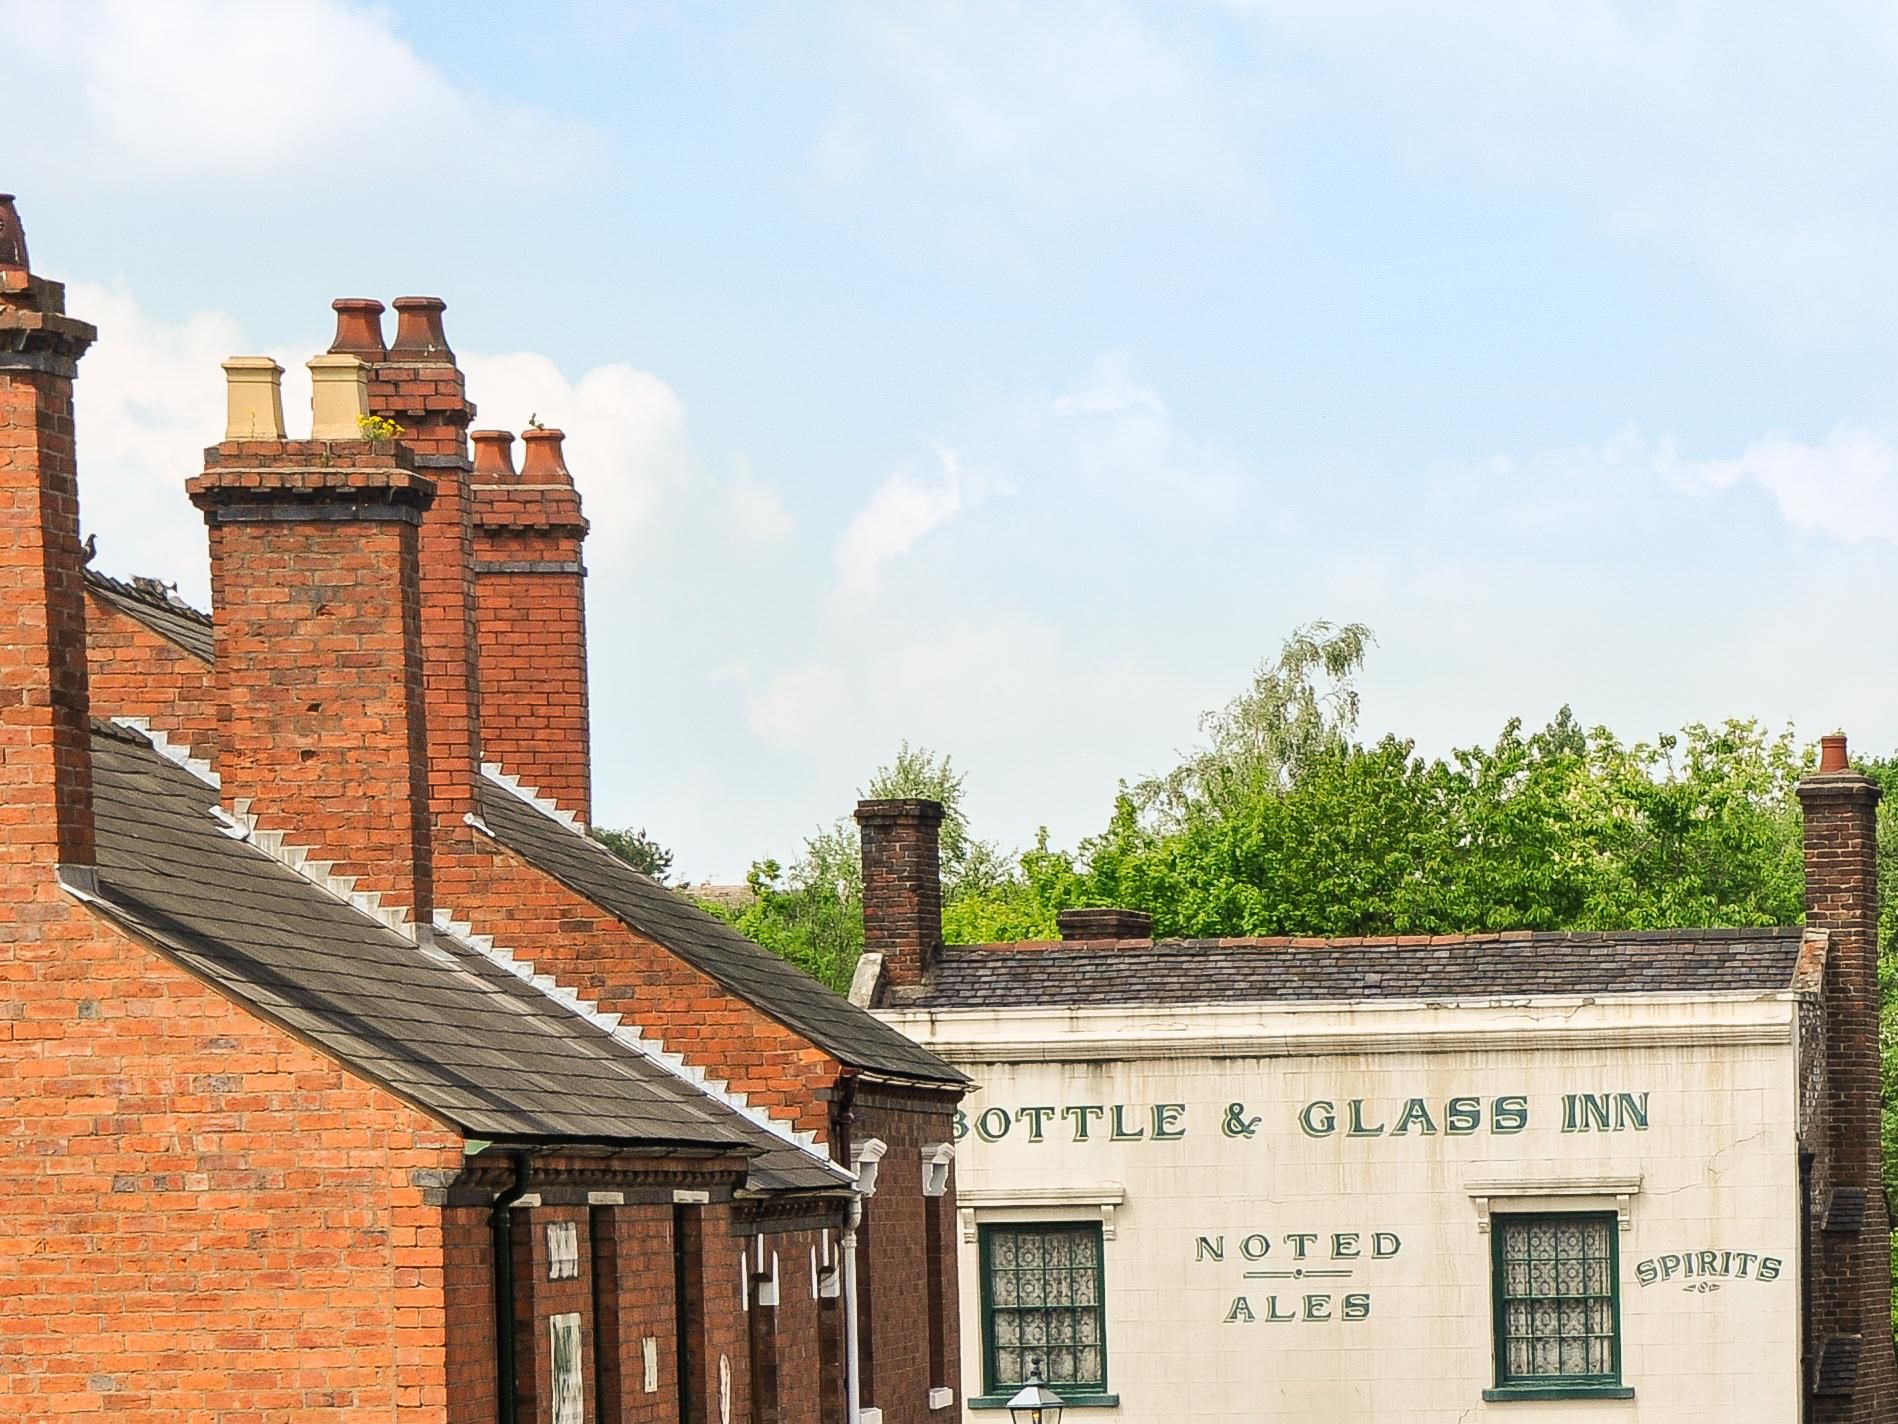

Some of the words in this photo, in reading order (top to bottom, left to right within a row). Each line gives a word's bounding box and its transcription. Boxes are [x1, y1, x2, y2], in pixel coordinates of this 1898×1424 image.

[1222, 1102, 1262, 1139] &
[1298, 1095, 1528, 1138] GLASS
[1561, 1092, 1650, 1133] INN
[1195, 1231, 1402, 1262] NOTED
[1635, 1250, 1783, 1288] SPIRITS
[1222, 1293, 1372, 1323] ALES
